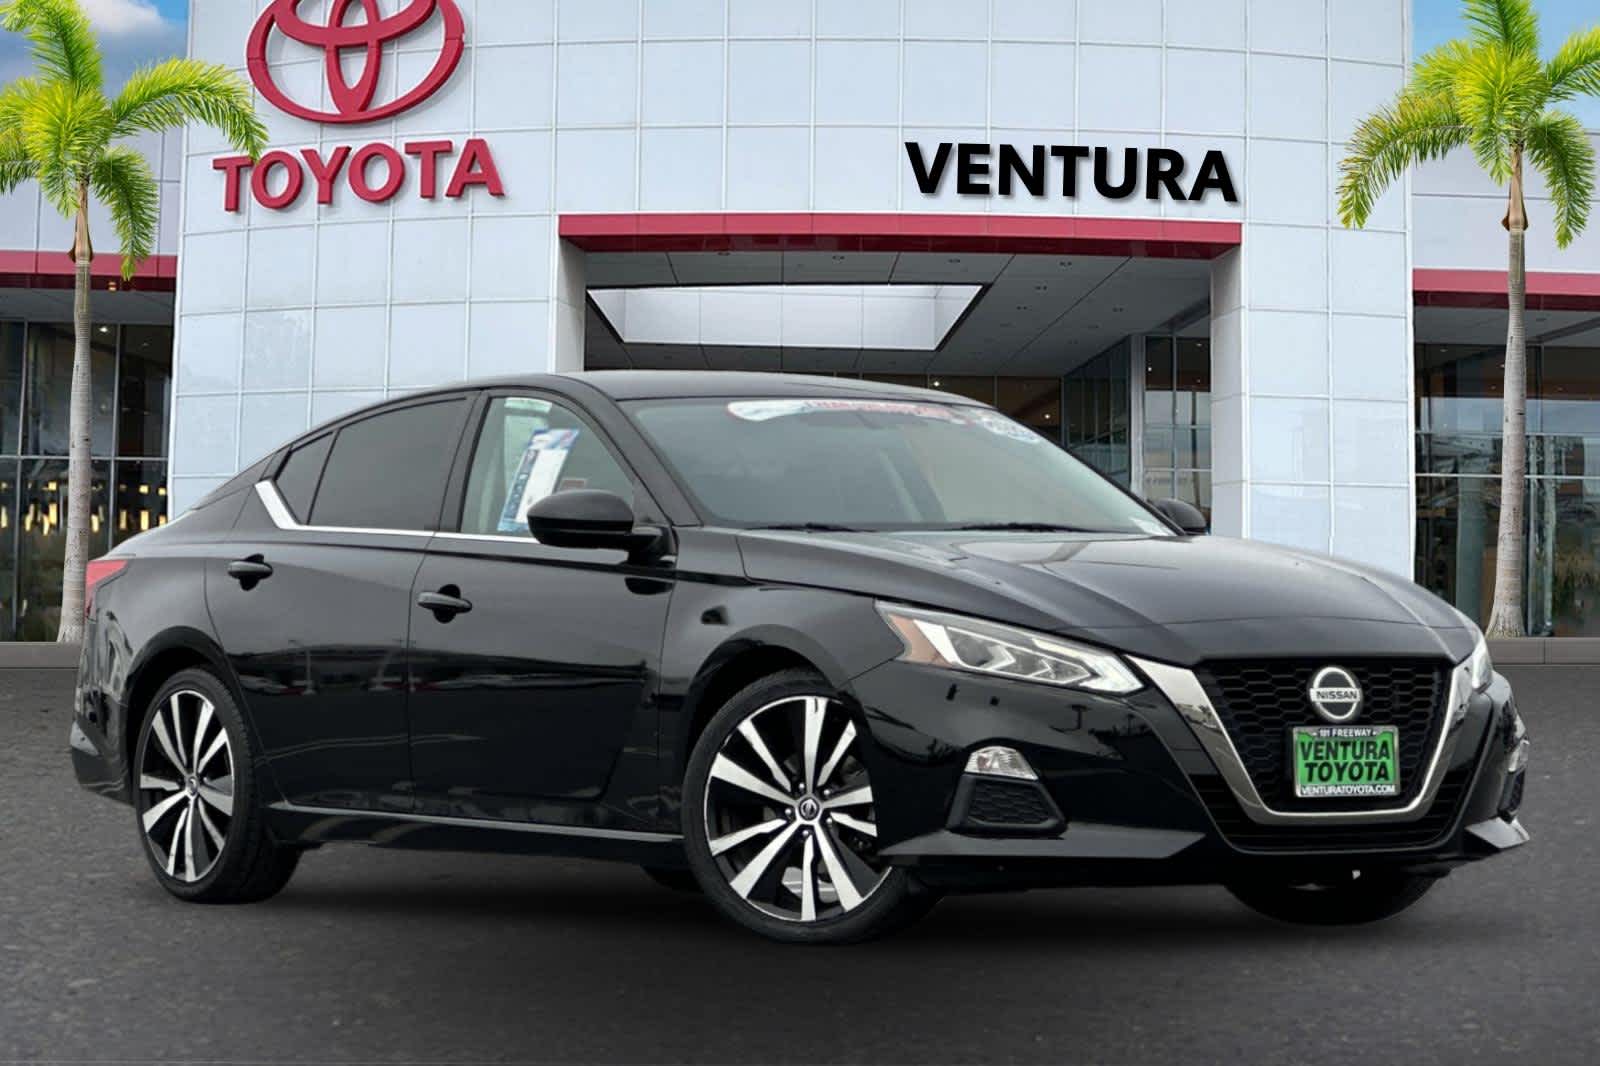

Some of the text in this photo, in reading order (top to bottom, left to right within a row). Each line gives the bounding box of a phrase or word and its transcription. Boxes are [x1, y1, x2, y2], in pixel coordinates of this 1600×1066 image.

[212, 138, 504, 212] TOYOTA
[905, 142, 1238, 202] VENTURA
[1316, 690, 1358, 699] NISSAN
[1332, 729, 1372, 737] FREEWAY
[1300, 740, 1390, 760] VENTURA
[1304, 761, 1390, 782] TOYOTA
[1301, 784, 1395, 795] VENTURATOYOTA.COM
